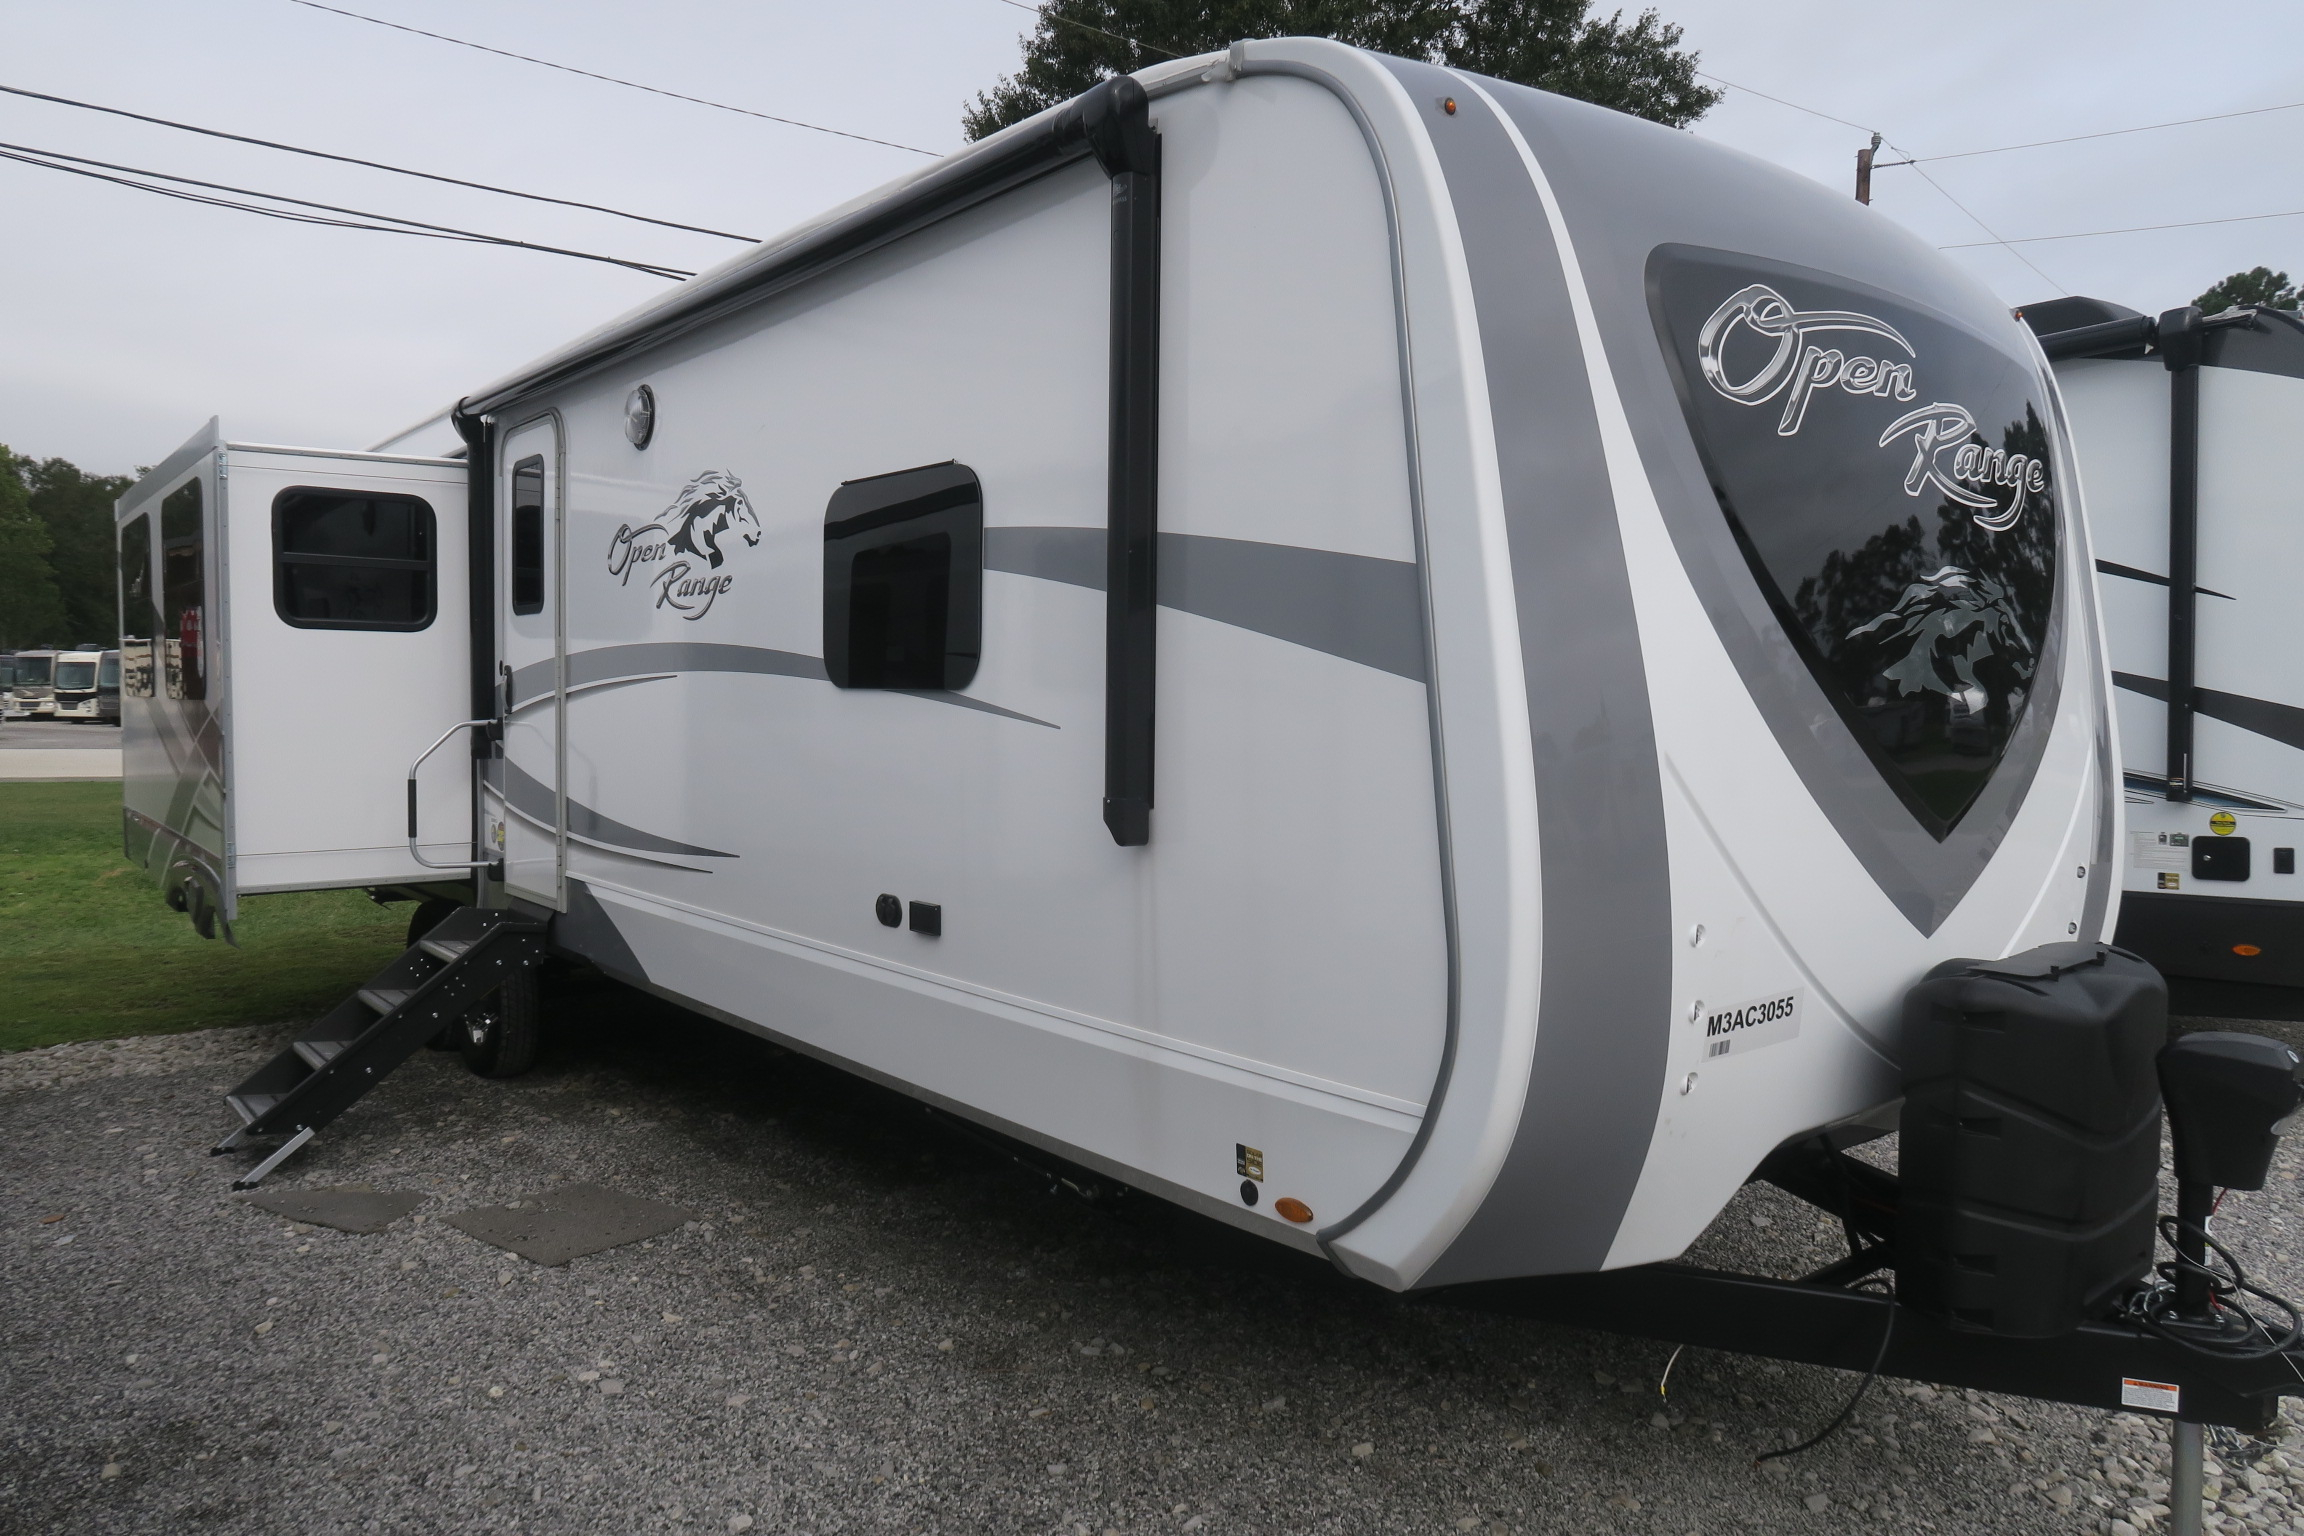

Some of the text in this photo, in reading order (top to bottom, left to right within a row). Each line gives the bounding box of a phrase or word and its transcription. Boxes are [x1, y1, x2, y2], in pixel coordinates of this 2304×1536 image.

[1698, 284, 1916, 436] Open
[1879, 402, 2045, 532] Range
[607, 523, 669, 587] Open
[650, 560, 733, 621] Range
[1707, 996, 1794, 1037] M3AC3055
